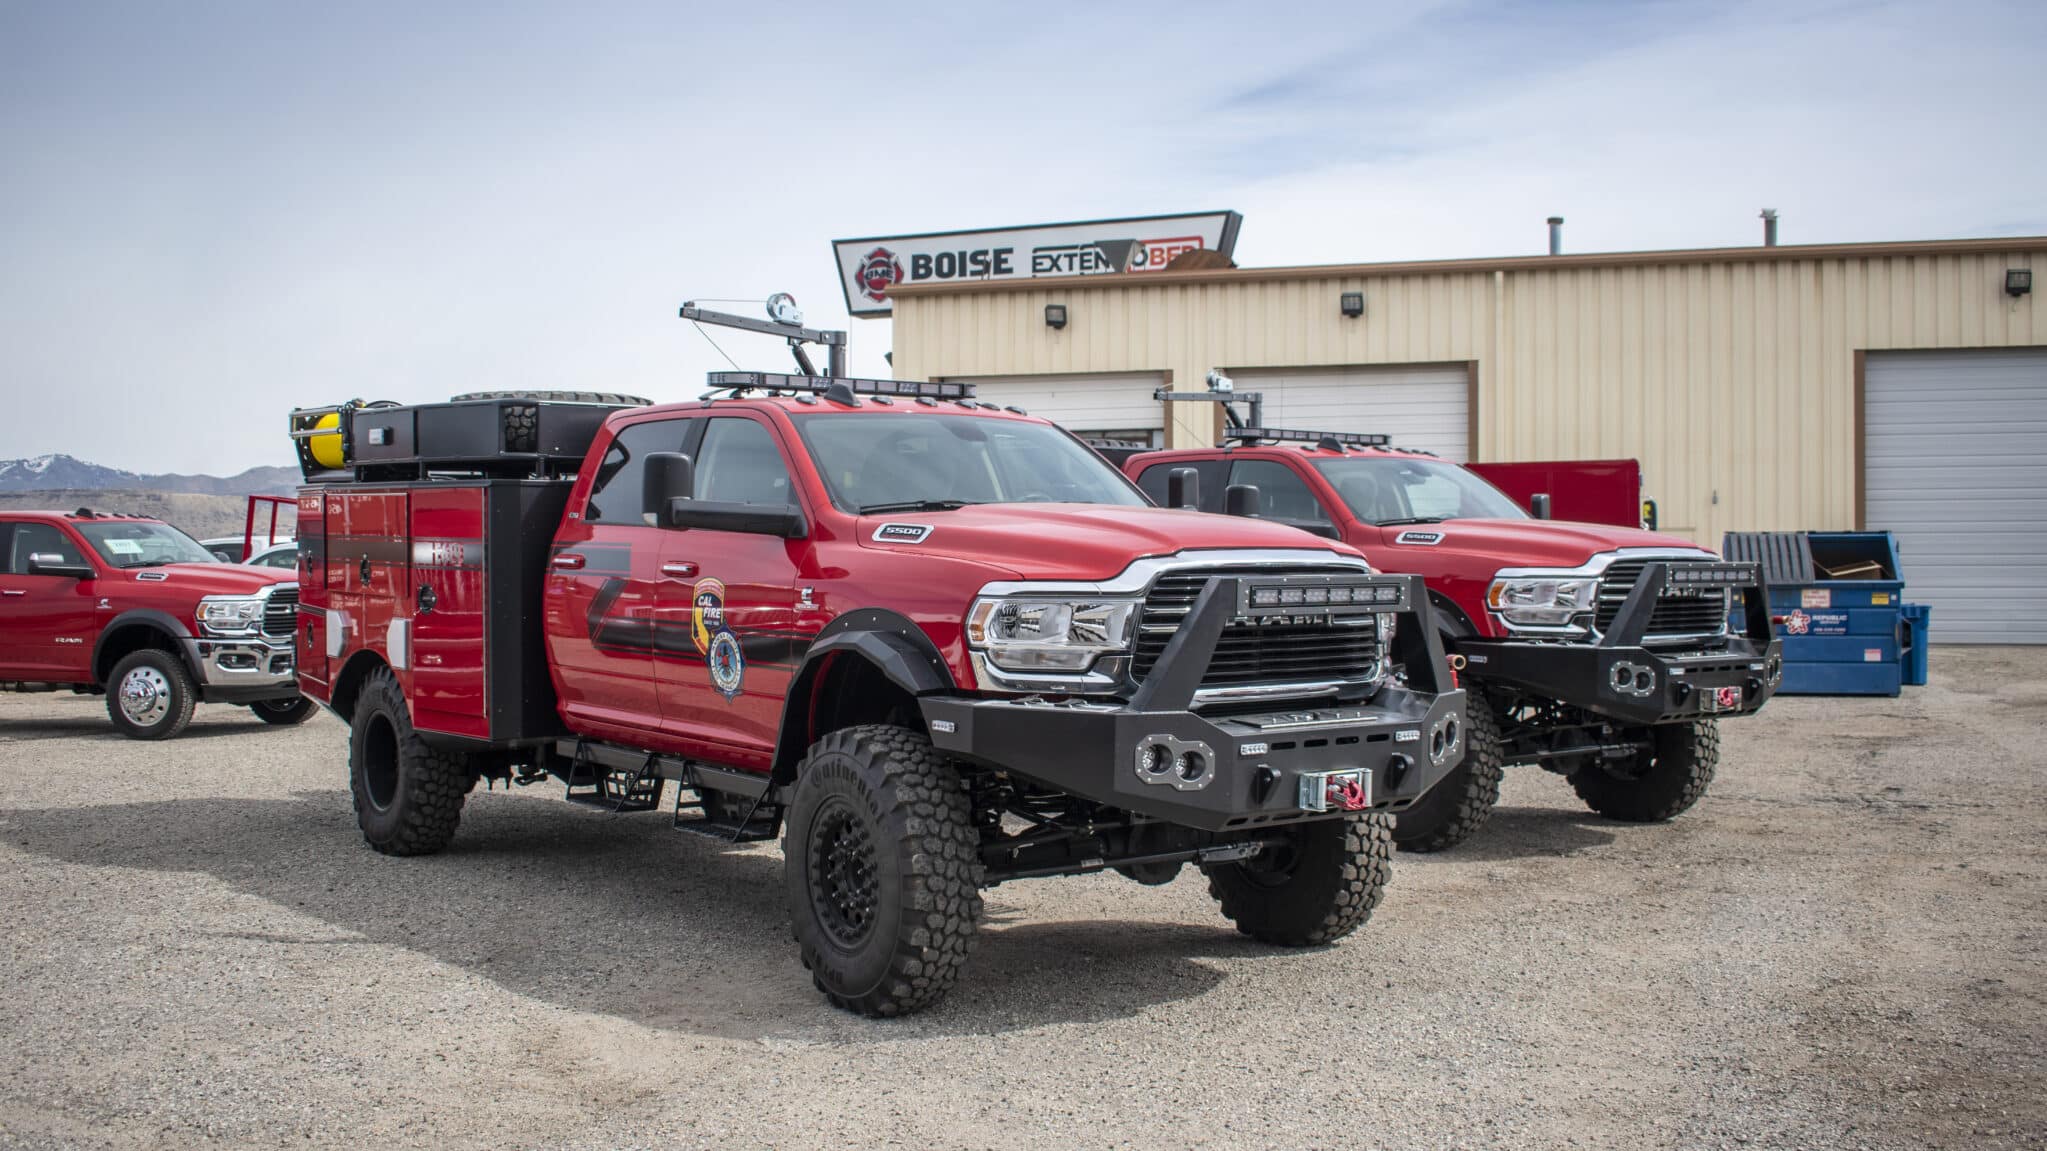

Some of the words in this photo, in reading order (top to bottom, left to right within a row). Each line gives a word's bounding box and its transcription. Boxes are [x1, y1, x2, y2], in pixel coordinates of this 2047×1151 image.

[911, 247, 1014, 281] BOISE
[1032, 245, 1194, 273] EXTENOBE
[886, 527, 922, 535] 5500
[698, 595, 713, 607] CAL
[703, 607, 721, 619] FIRE
